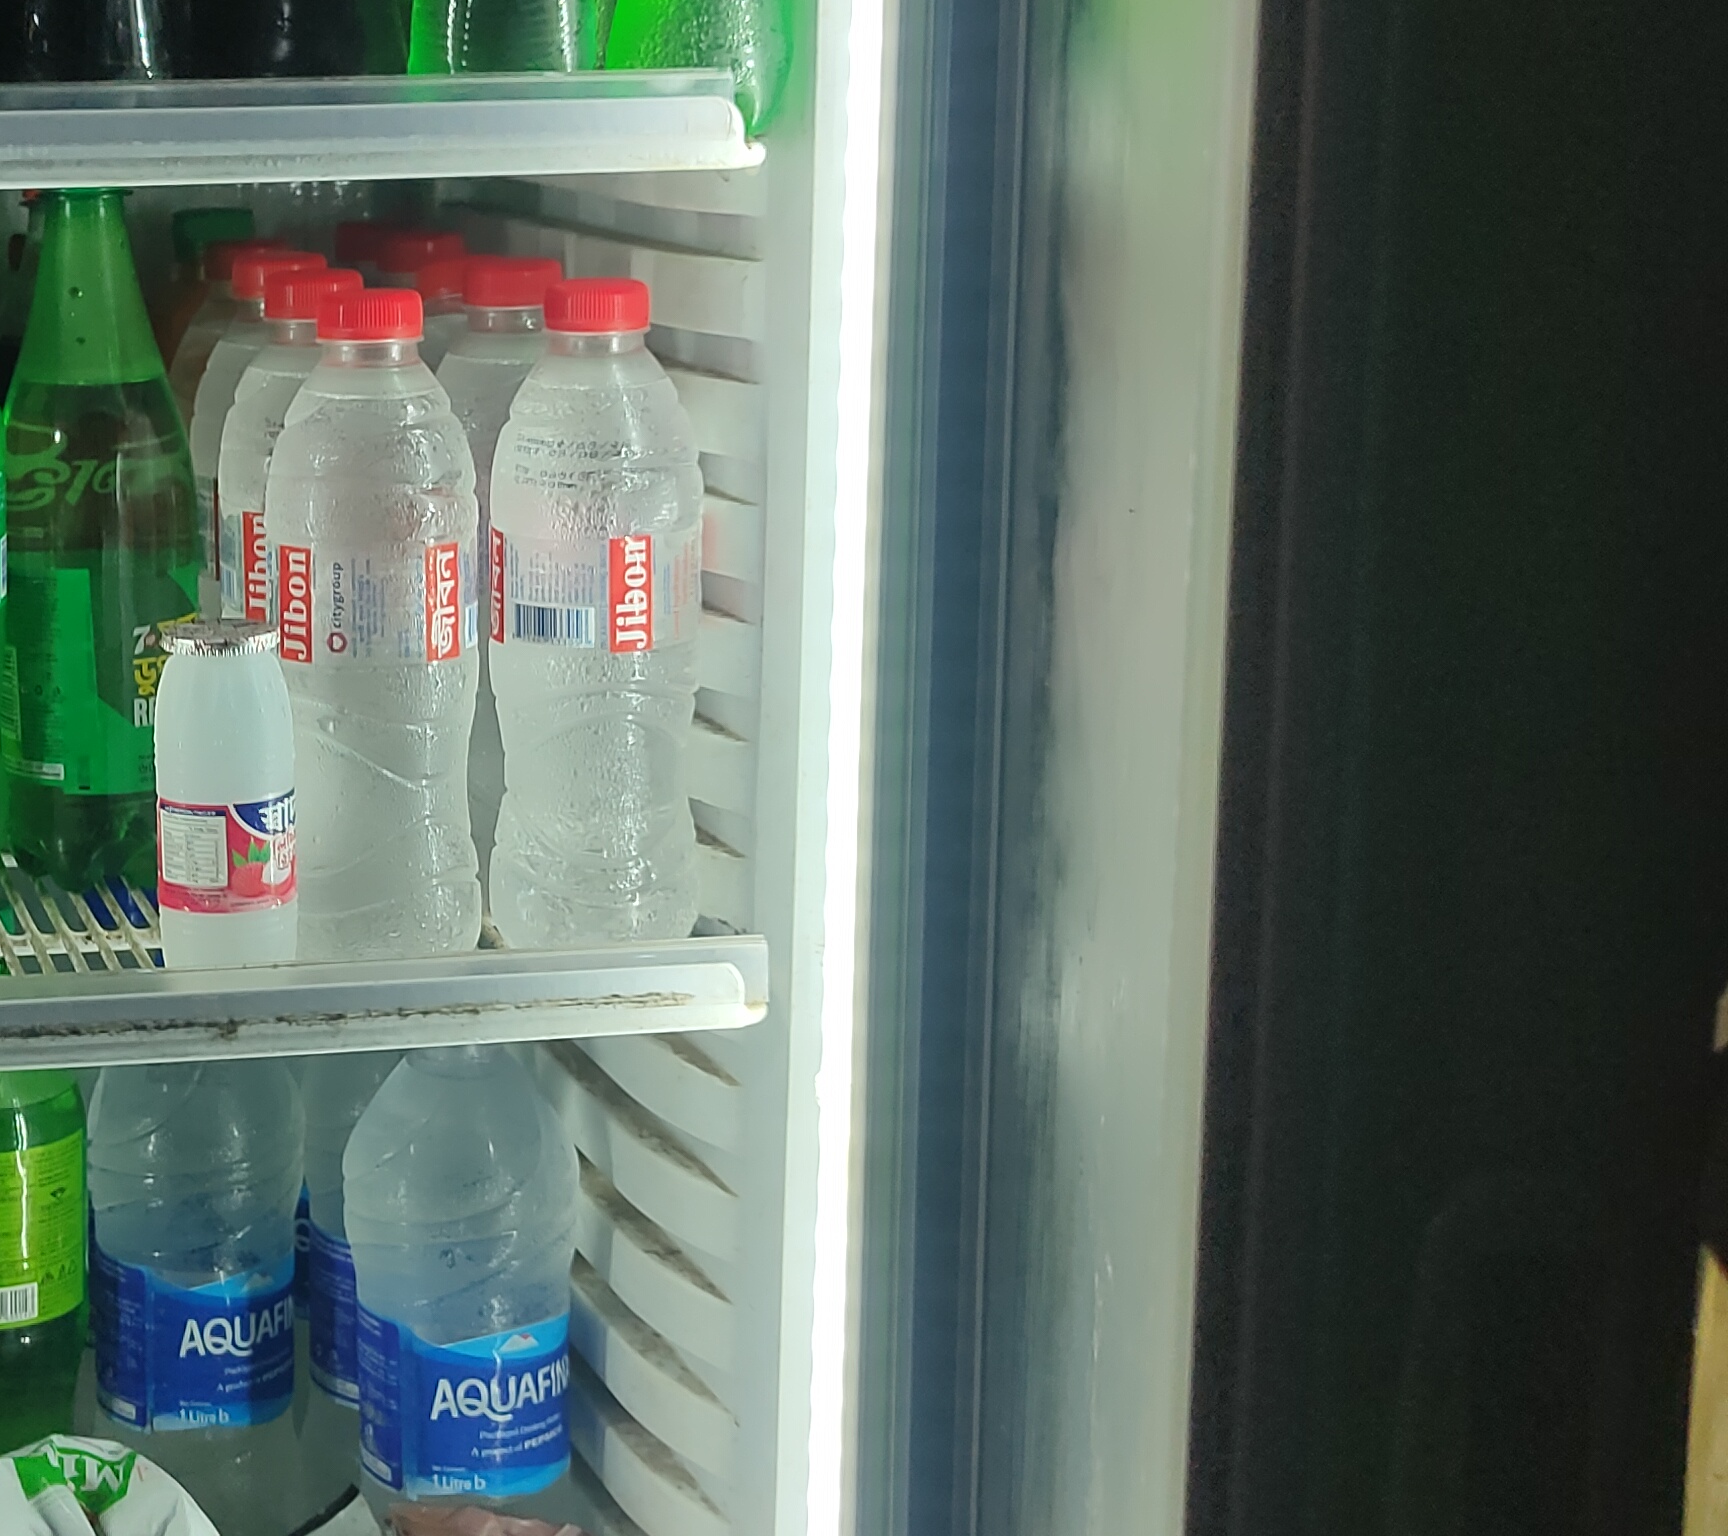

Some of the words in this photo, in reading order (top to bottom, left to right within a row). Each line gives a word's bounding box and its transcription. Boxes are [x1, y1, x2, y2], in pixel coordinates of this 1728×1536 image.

[282, 550, 309, 661] Jibon
[330, 561, 344, 629] citygroup
[430, 548, 458, 659] জীবন
[615, 534, 648, 650] Jibon
[442, 1475, 472, 1491] Litre
